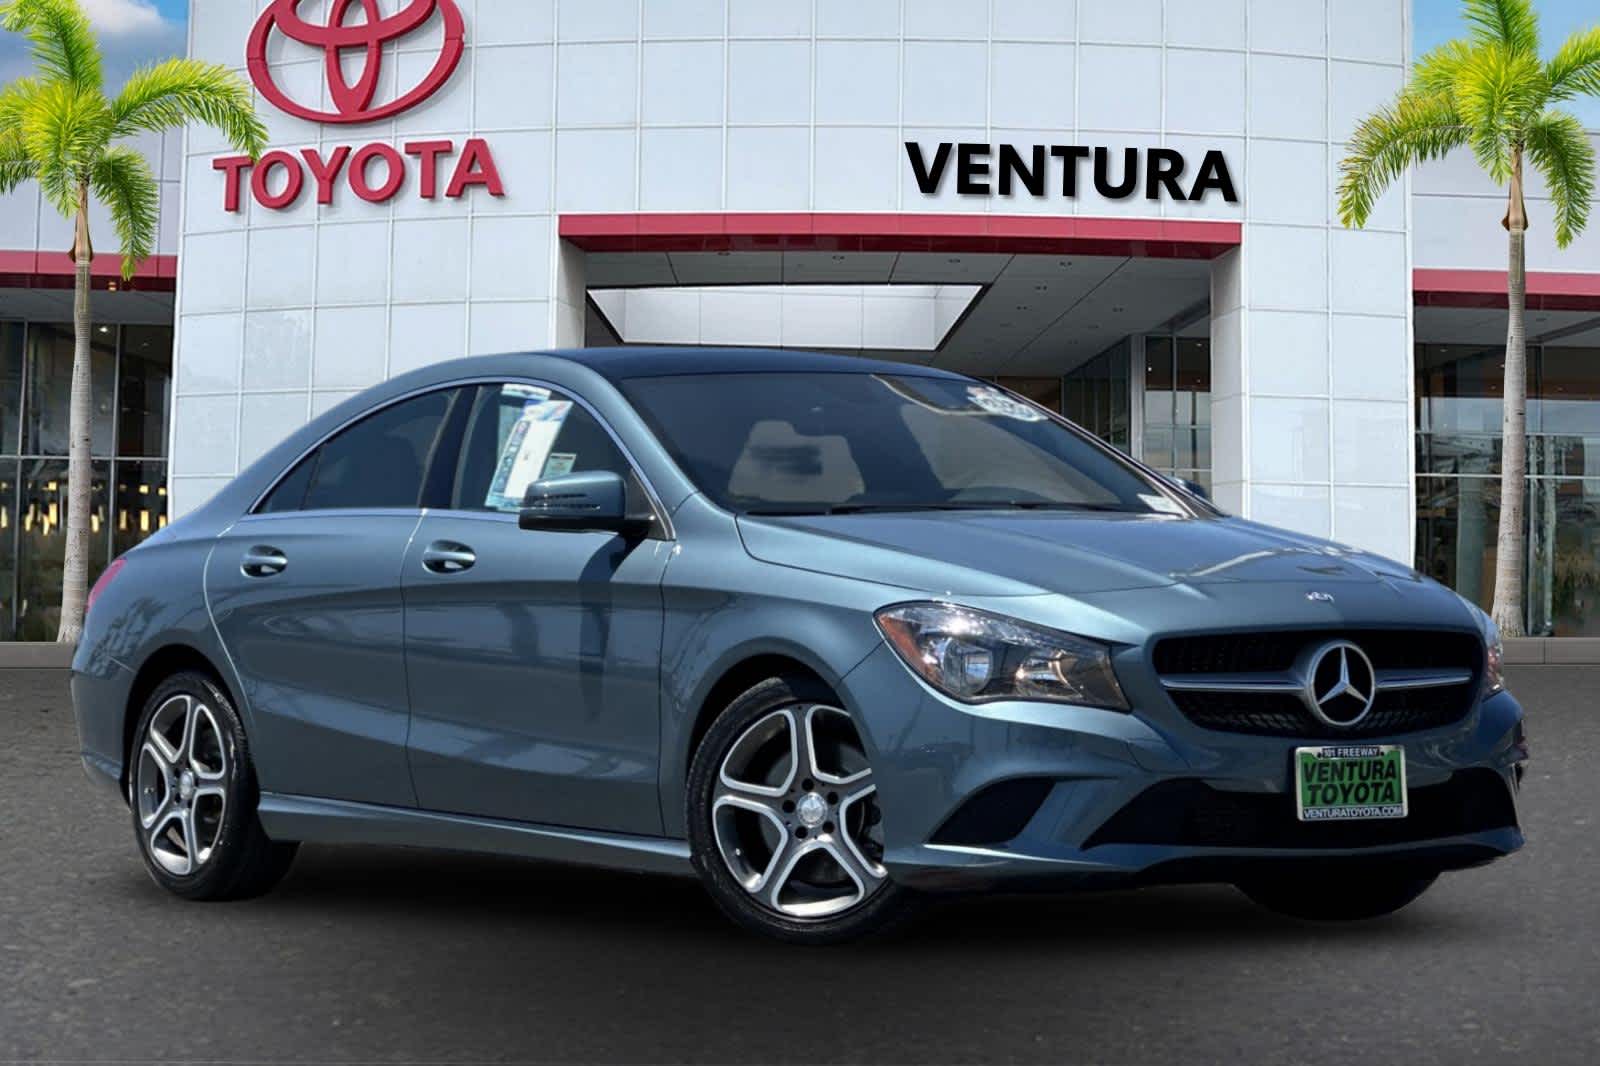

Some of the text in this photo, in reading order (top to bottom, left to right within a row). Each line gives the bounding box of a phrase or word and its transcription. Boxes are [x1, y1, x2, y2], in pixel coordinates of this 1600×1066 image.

[213, 138, 504, 212] TOYOTA
[905, 141, 1238, 203] VENTURA
[1337, 747, 1378, 757] FREEWAY
[1304, 759, 1397, 782] VENTURA
[1307, 782, 1395, 805] TOYOTA
[1304, 807, 1402, 818] VENTURATOYOTA.COM
